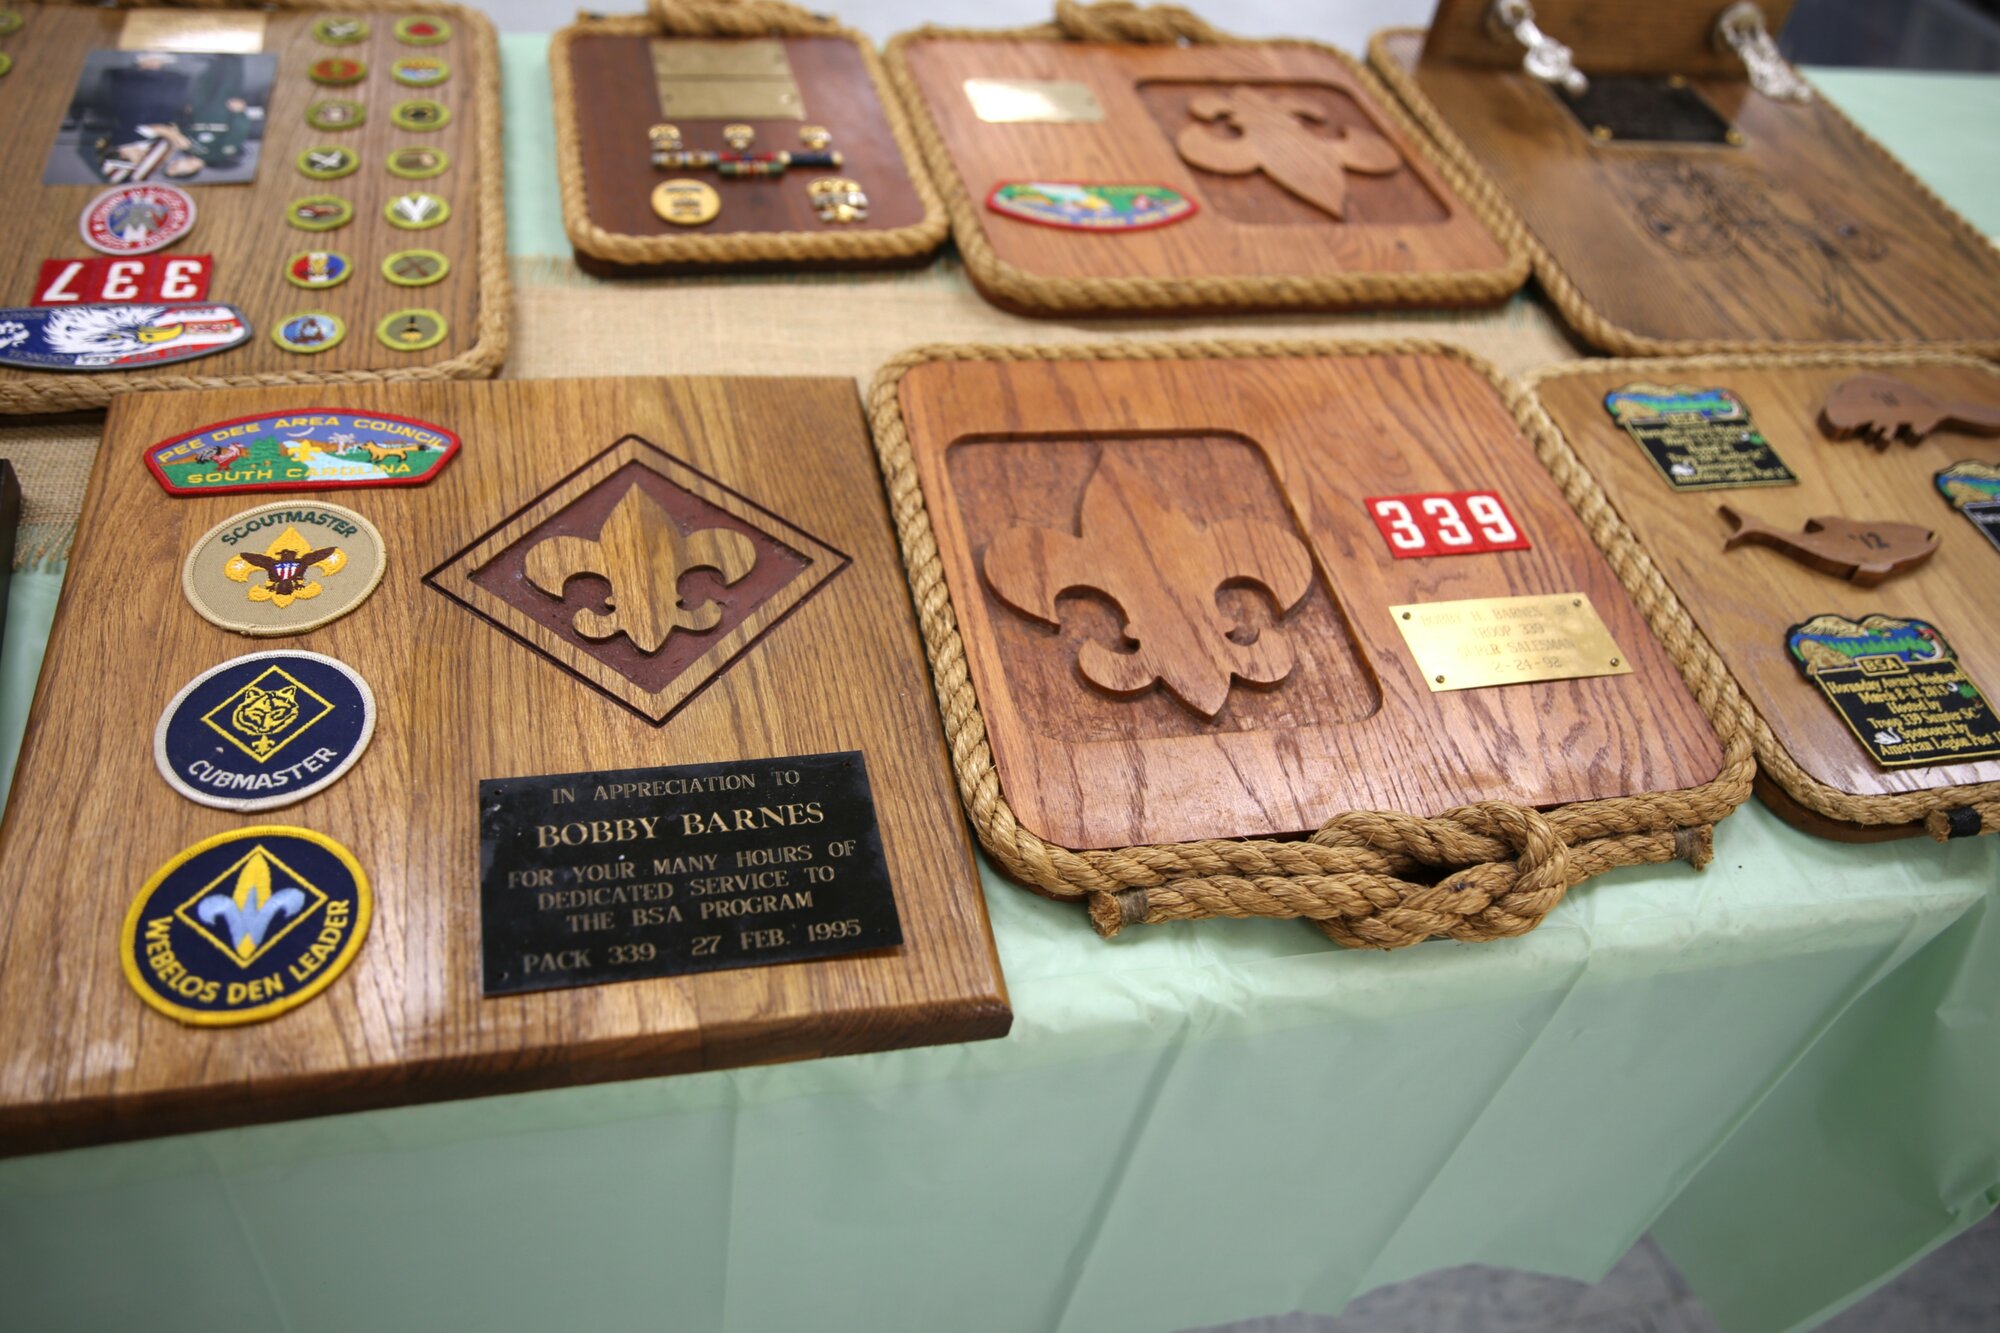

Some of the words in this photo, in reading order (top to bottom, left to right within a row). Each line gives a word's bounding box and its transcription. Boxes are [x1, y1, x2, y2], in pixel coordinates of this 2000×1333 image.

[42, 259, 203, 302] 337
[158, 437, 206, 463] PEE
[211, 422, 262, 441] DEE
[273, 416, 340, 430] AREA
[353, 417, 445, 449] COUNCIL
[187, 468, 273, 484] SOUTH
[285, 462, 412, 478] CAROLINA
[221, 509, 358, 547] SCOUTMASTER
[1375, 495, 1518, 550] 339
[1492, 605, 1543, 620] BARNES
[1521, 623, 1545, 635] 339
[1507, 639, 1575, 654] SALESMAN
[1862, 657, 1901, 672] BSA
[1881, 674, 1918, 688] Award
[1913, 670, 1967, 684] Weekend
[1857, 691, 1898, 705] March
[1887, 698, 1927, 714] Hosted
[1923, 697, 1943, 712] by
[1866, 717, 1905, 733] Troop
[1900, 712, 1922, 726] 339
[1921, 710, 1962, 724] Sumter
[1897, 723, 1956, 742] Sponsored
[1952, 722, 1973, 738] by
[1880, 740, 1934, 756] American
[1931, 736, 1972, 752] Legion
[188, 746, 338, 792] CUBMASTER
[551, 787, 576, 805] IN
[593, 773, 757, 801] APPRECIATION
[771, 770, 801, 787] TO
[536, 816, 660, 849] BOBBY
[680, 801, 825, 836] BARNES
[507, 869, 554, 890] FOR
[572, 861, 637, 883] YOUR
[653, 853, 718, 876] MANY
[736, 844, 813, 868] HOURS
[827, 839, 857, 858] OF
[537, 882, 674, 911] DEDICATED
[689, 870, 788, 897] SERVICE
[803, 864, 836, 884] TO
[565, 911, 616, 934] THE
[632, 905, 683, 928] BSA
[700, 890, 814, 921] PROGRAM
[144, 915, 222, 1004] WEBELOS
[226, 972, 285, 1005] DEN
[288, 898, 350, 982] LEADER
[522, 949, 592, 975] PACK
[607, 943, 657, 966] 339
[690, 935, 722, 957] 27
[739, 928, 791, 951] FEB.
[806, 918, 862, 943] 1995
